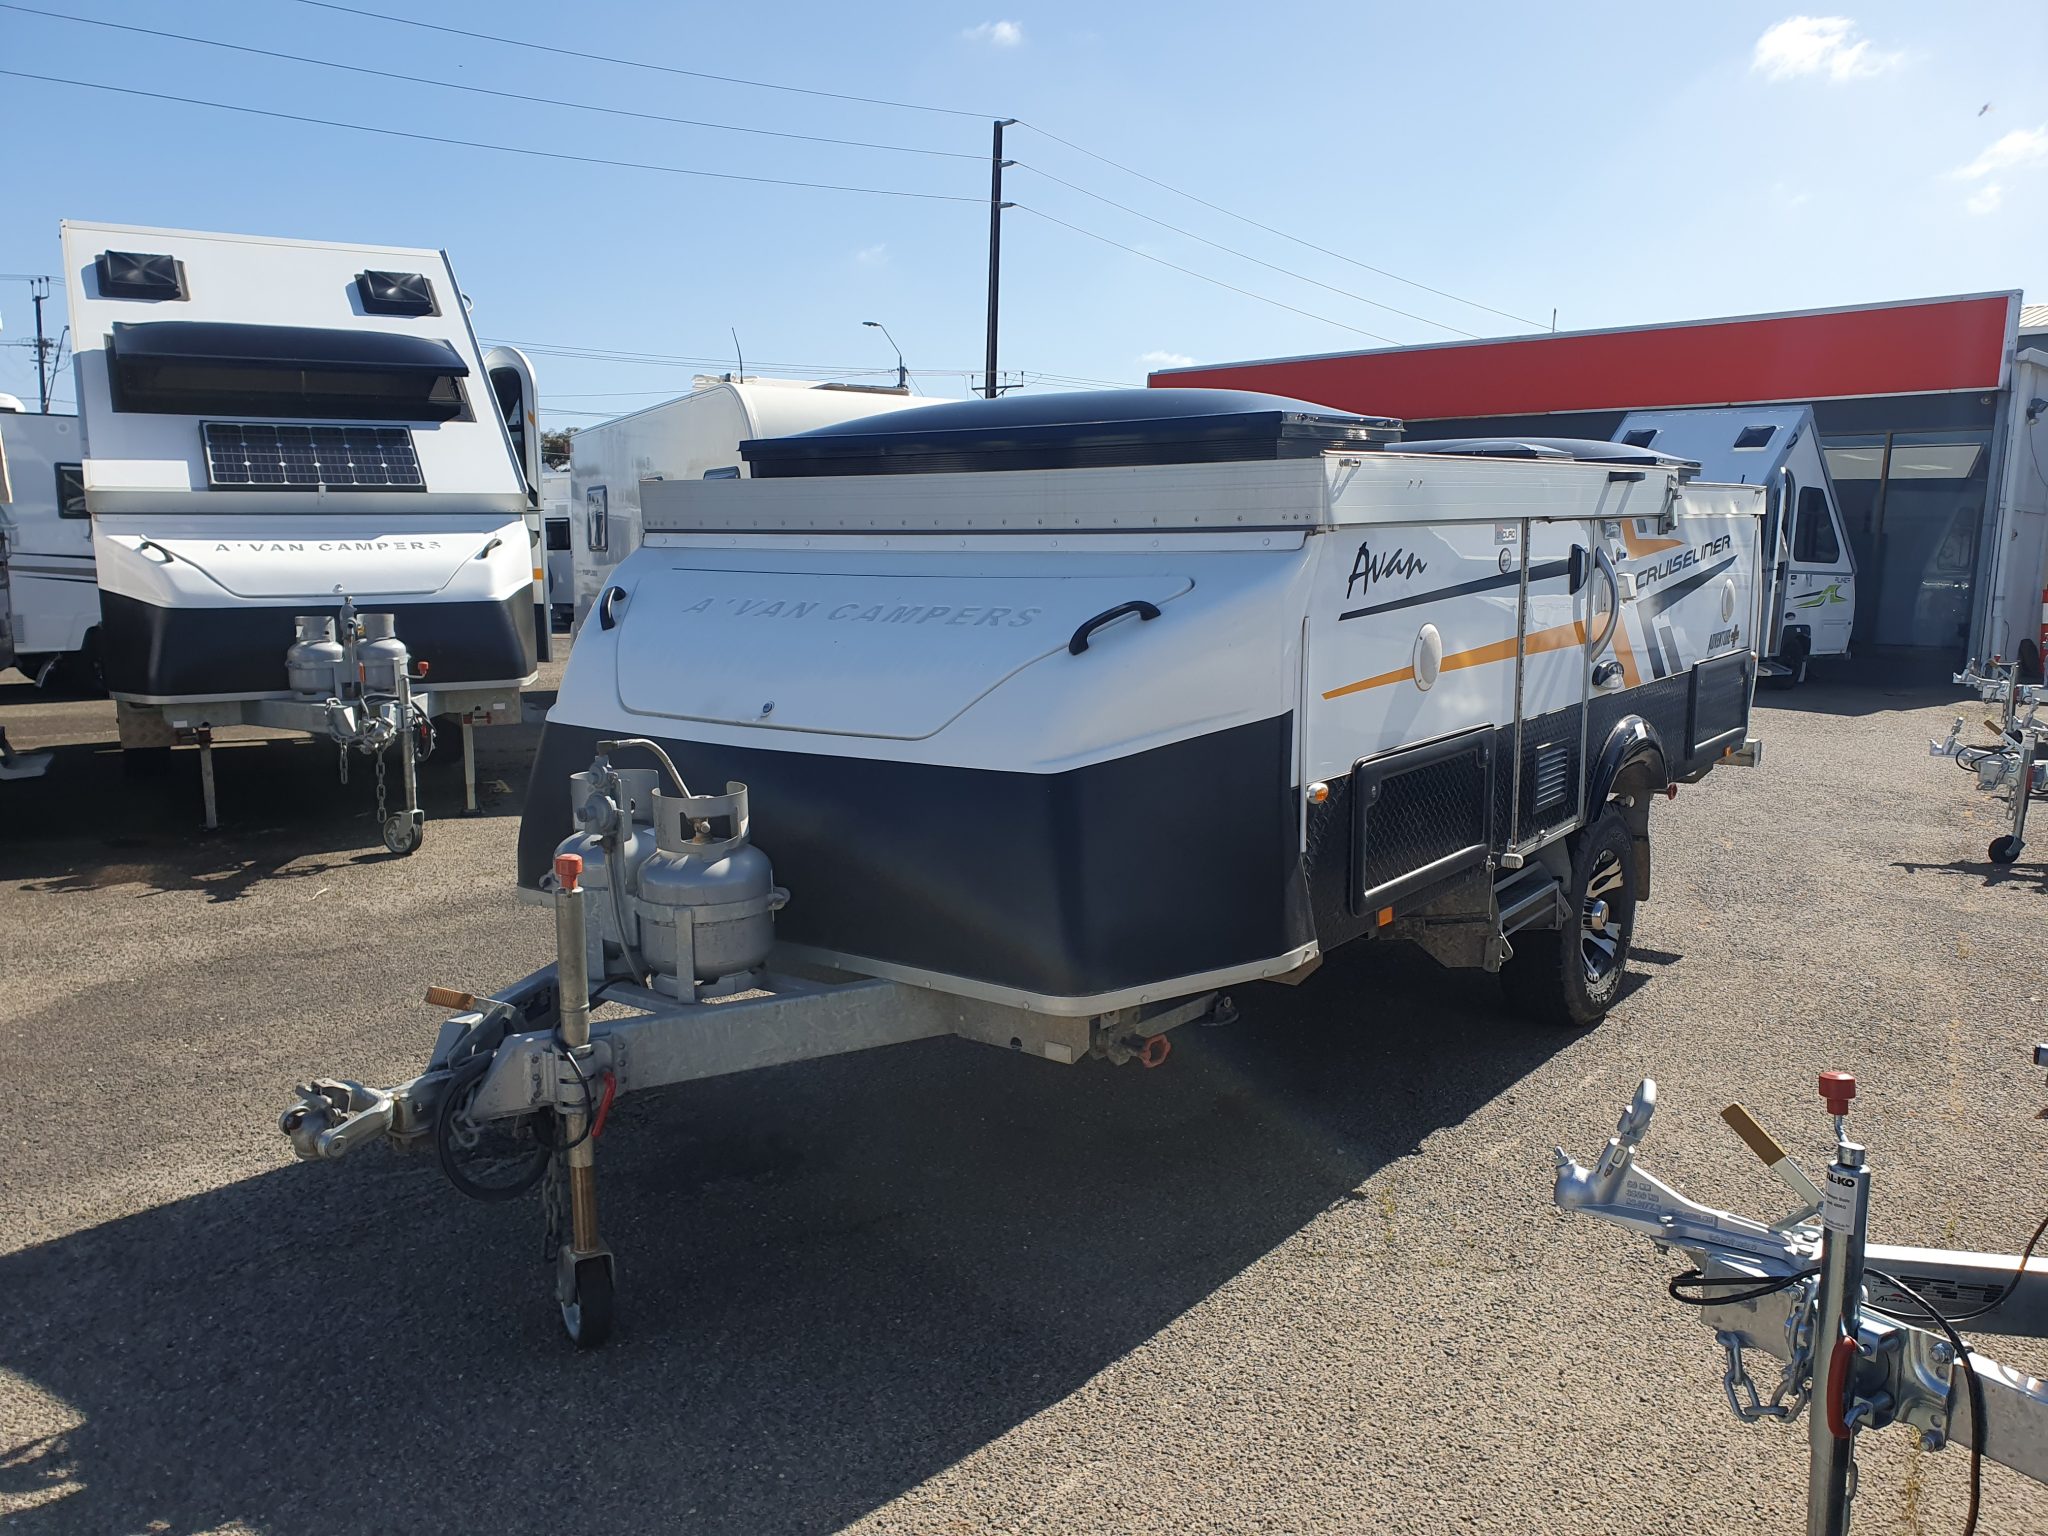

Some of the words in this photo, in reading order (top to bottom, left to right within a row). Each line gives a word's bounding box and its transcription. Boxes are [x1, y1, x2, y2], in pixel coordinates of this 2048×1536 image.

[215, 543, 305, 552] A'VAN
[318, 541, 442, 552] CAMPERS
[1636, 534, 1731, 590] CRUISELINER
[1346, 541, 1428, 600] Avan
[682, 598, 822, 619] A'VAN
[826, 602, 1043, 628] CAMPERS
